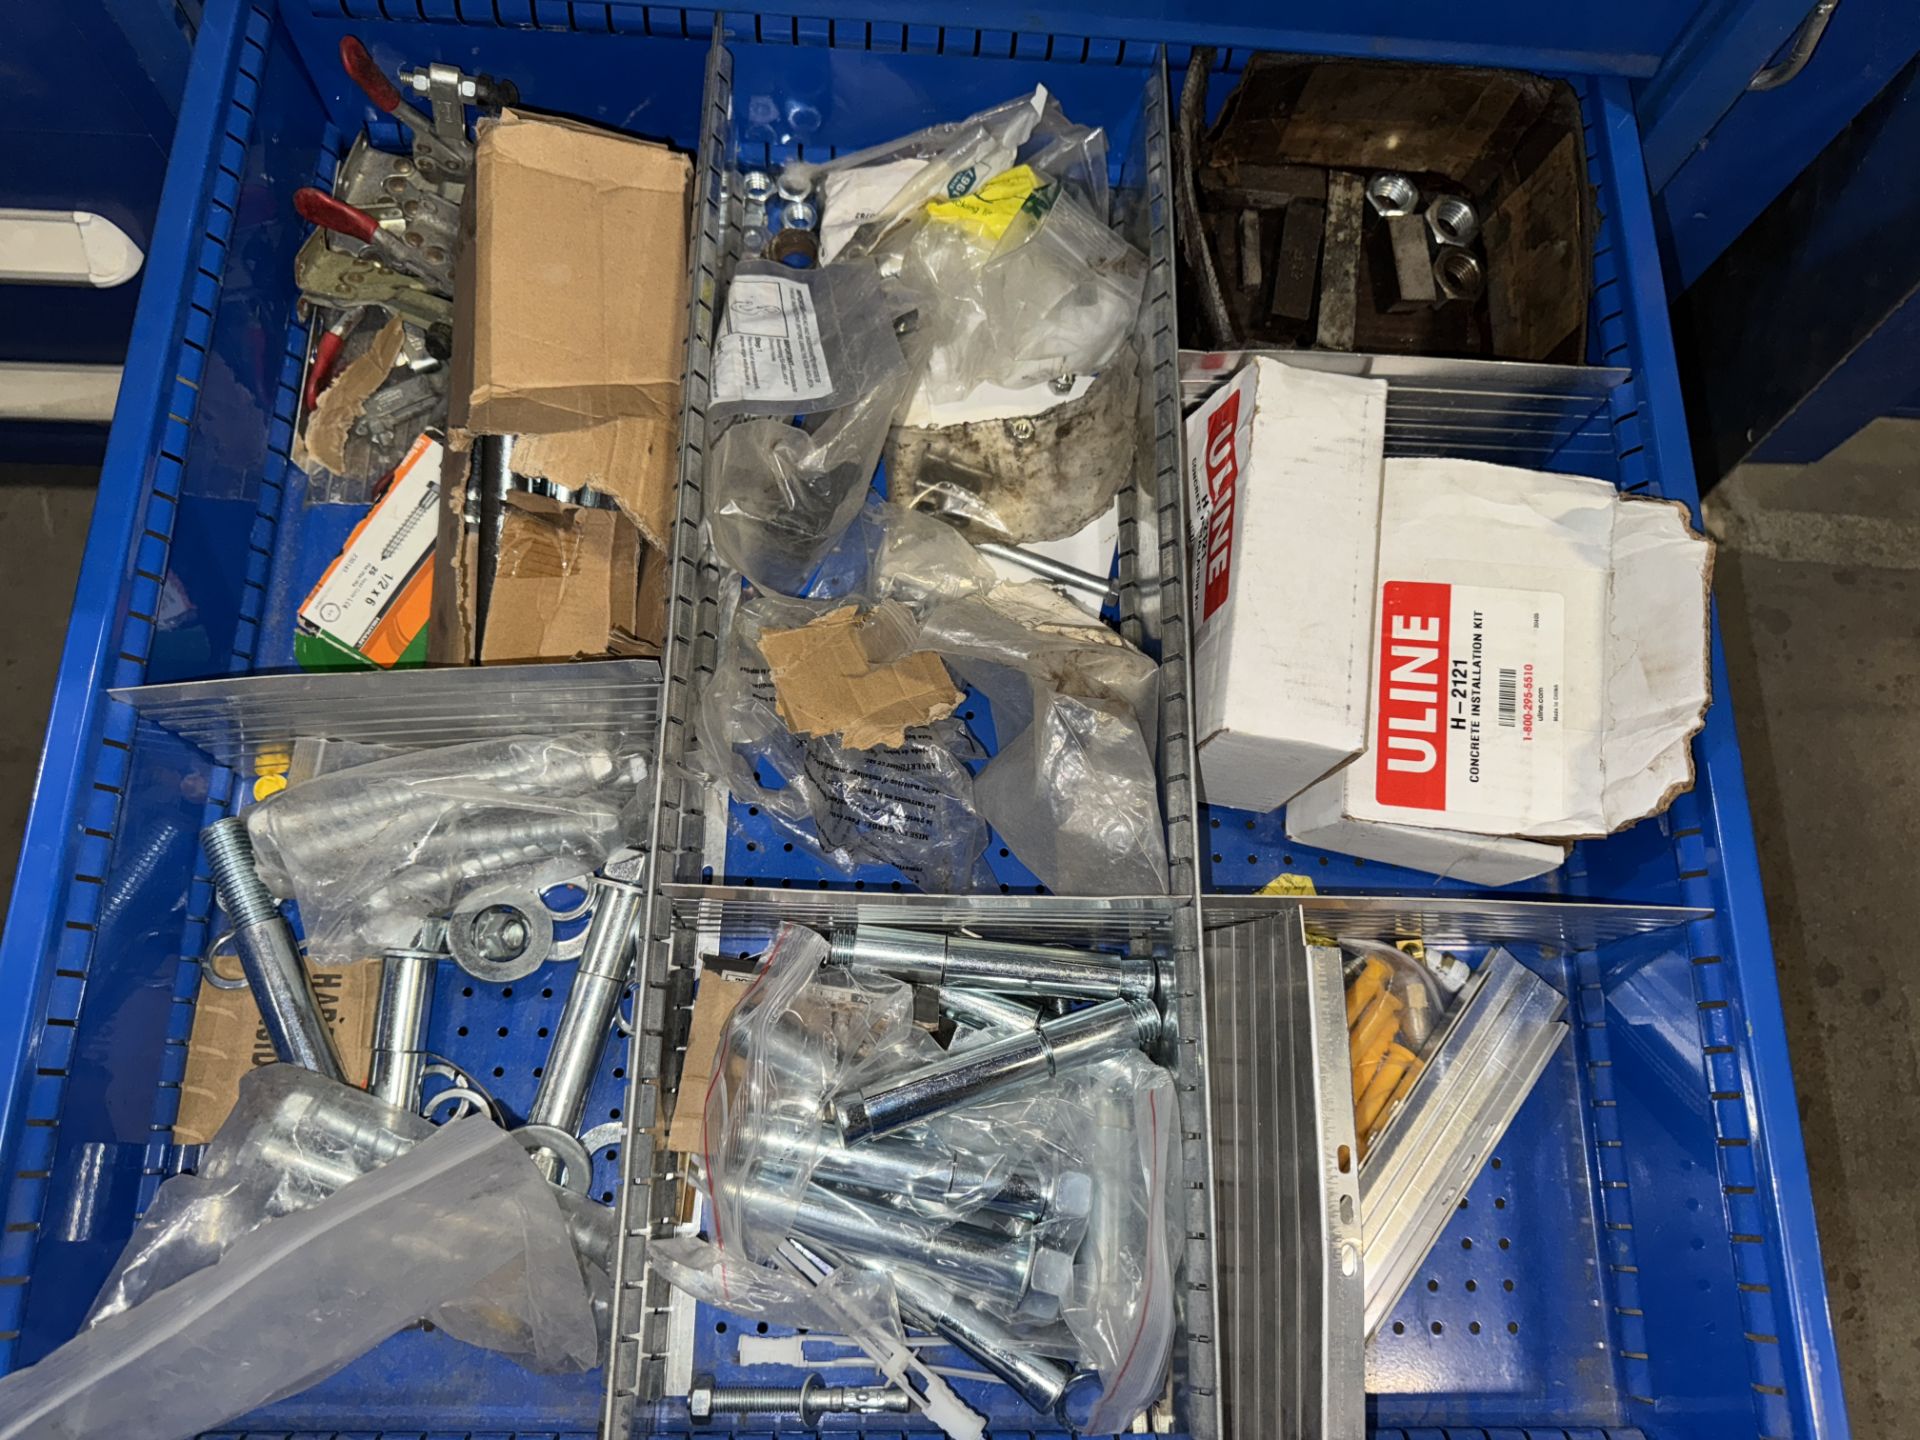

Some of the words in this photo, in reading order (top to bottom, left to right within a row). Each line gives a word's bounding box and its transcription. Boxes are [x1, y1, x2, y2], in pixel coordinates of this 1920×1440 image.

[952, 170, 974, 197] 1967
[1208, 422, 1234, 585] ULINE
[365, 597, 376, 606] 6
[378, 573, 394, 590] 1/2
[1473, 610, 1483, 629] KIT
[1387, 615, 1440, 773] ULINE
[1470, 633, 1482, 716] INSTALLATION
[1522, 664, 1534, 742] 1-800-295-5510
[1469, 720, 1480, 783] CONCRETE
